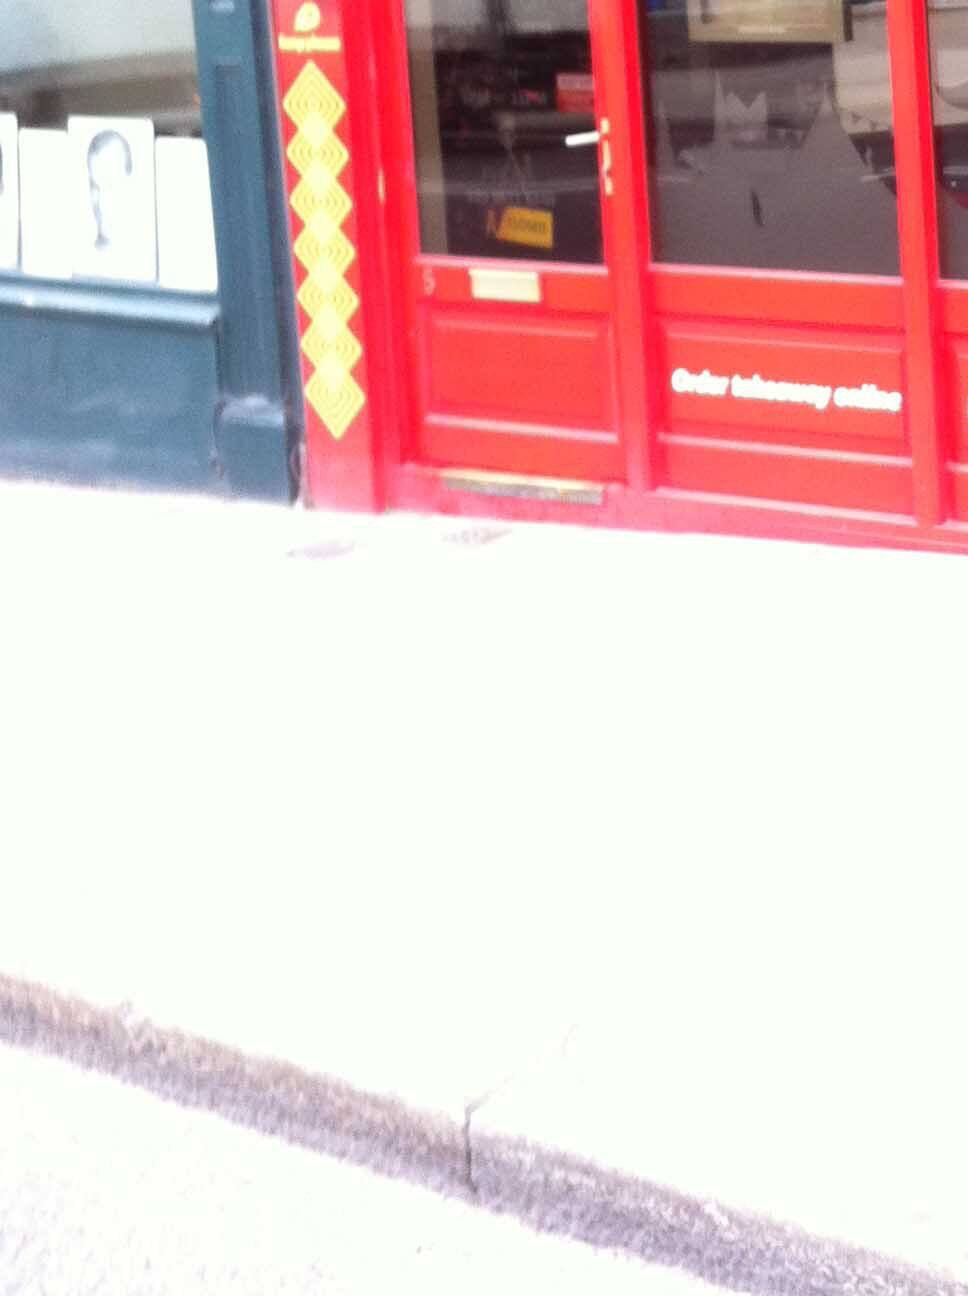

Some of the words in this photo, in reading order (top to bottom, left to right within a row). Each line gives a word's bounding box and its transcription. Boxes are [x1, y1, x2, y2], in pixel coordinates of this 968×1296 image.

[671, 367, 729, 395] Order
[731, 374, 832, 410] takeaway
[833, 383, 902, 412] online
